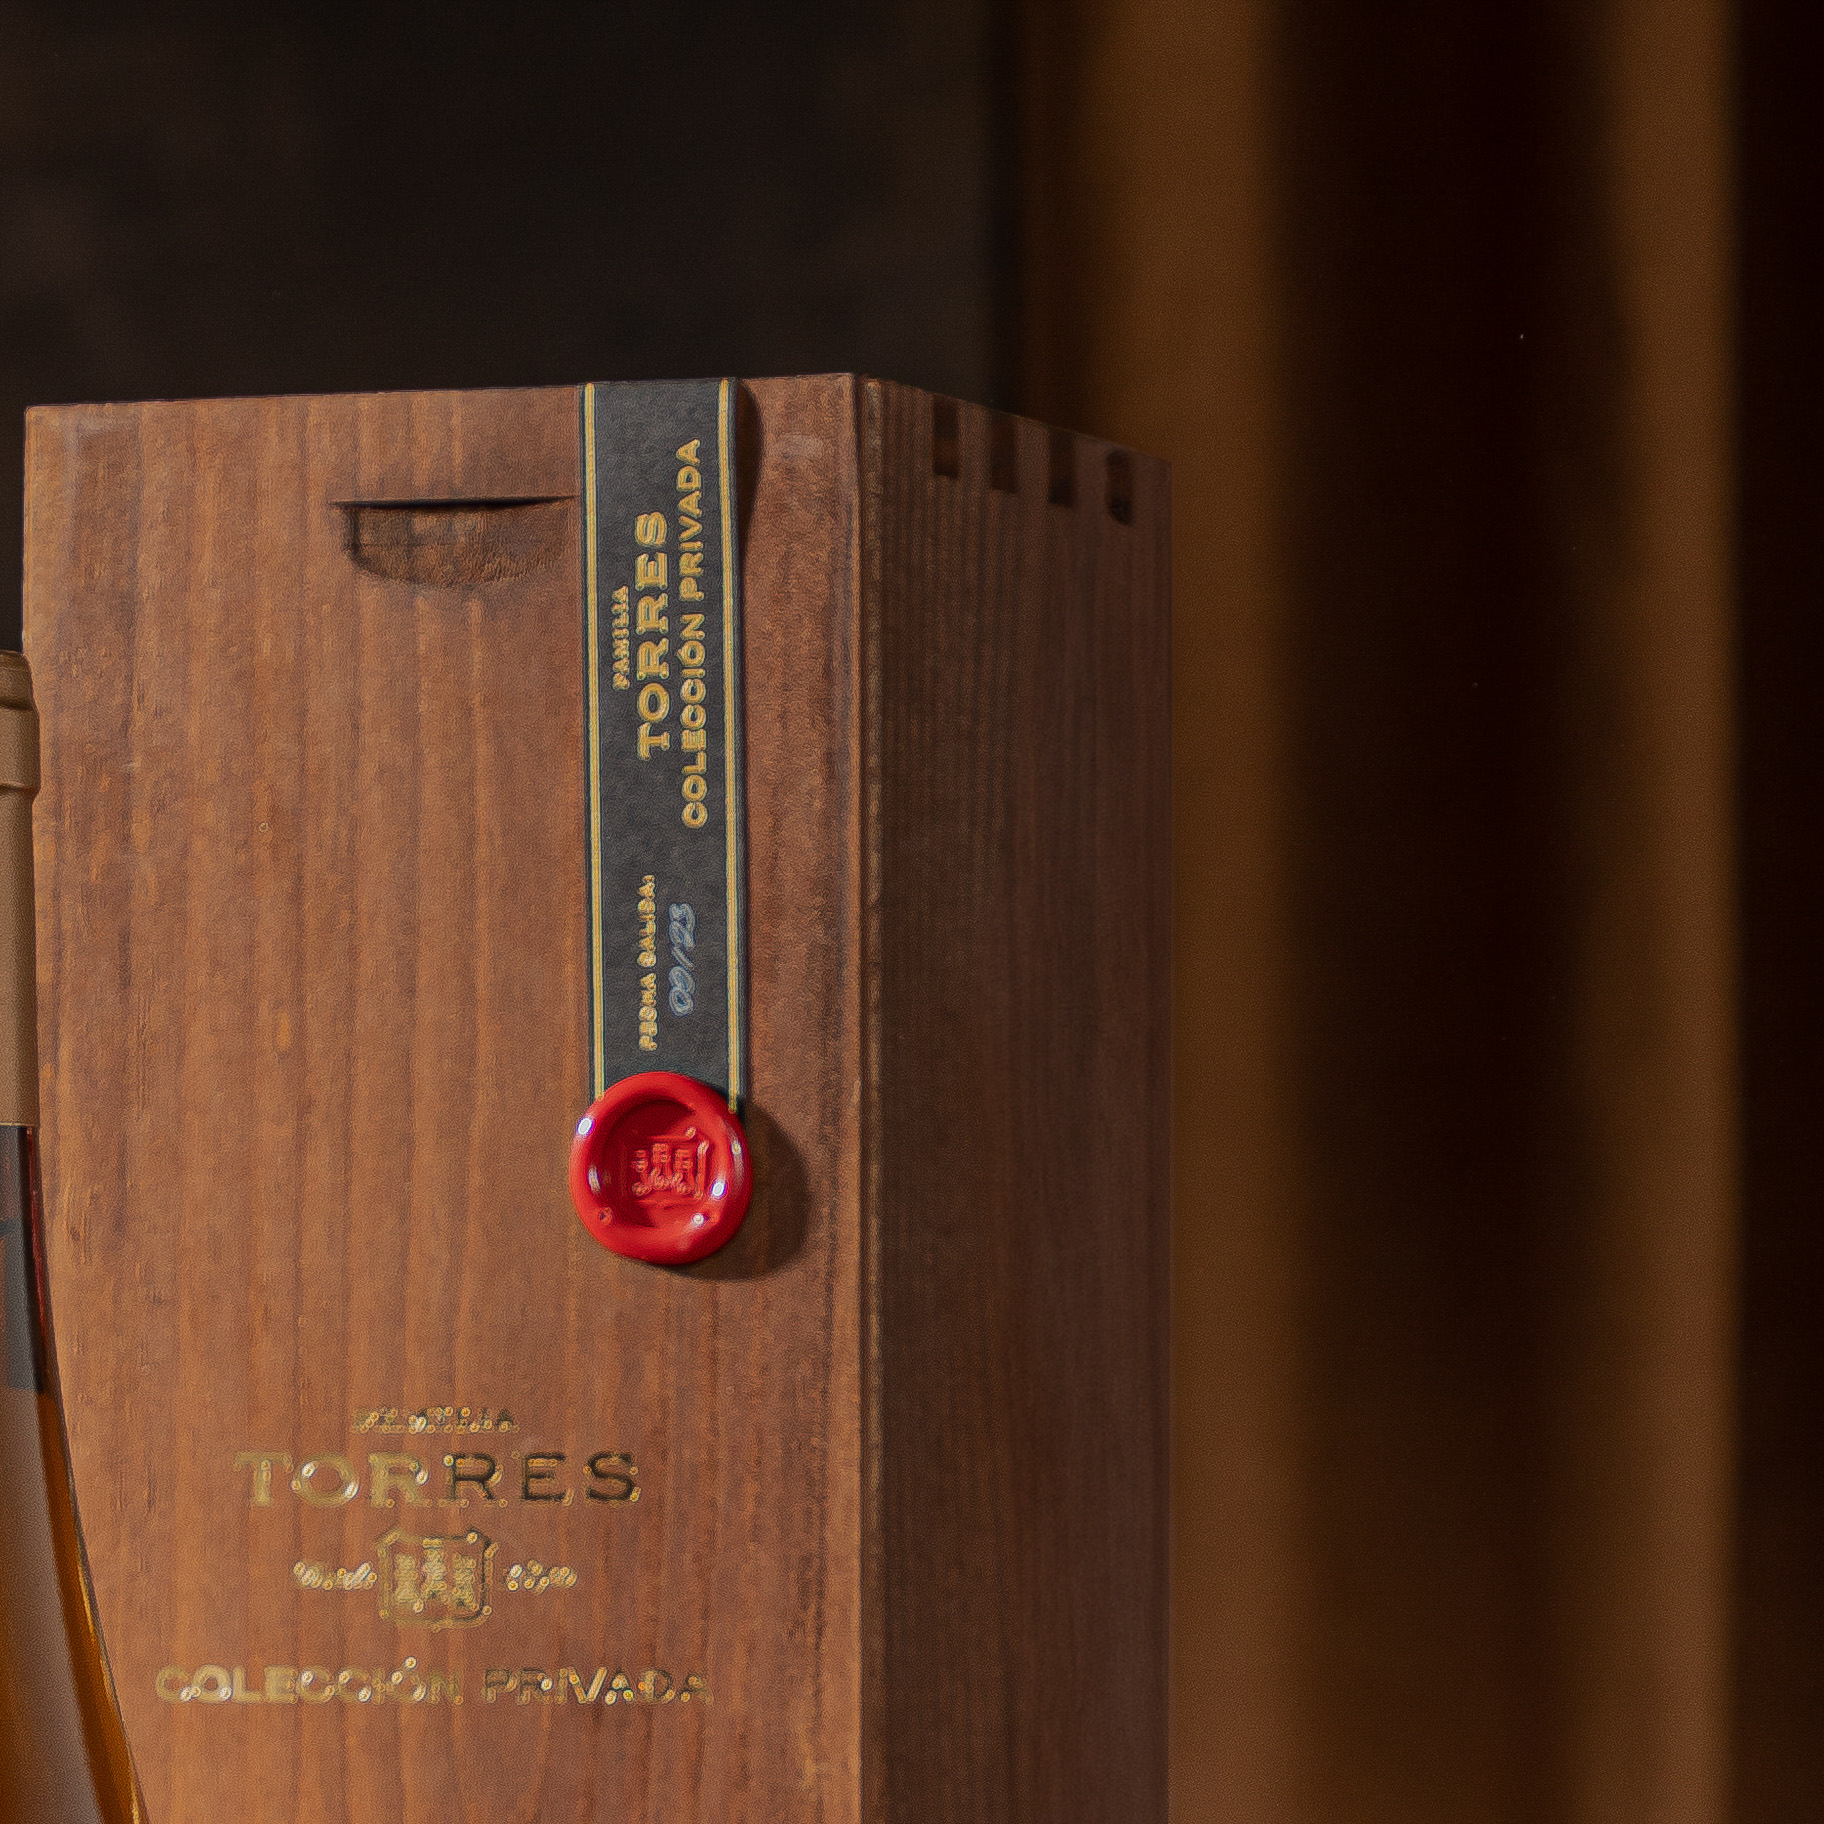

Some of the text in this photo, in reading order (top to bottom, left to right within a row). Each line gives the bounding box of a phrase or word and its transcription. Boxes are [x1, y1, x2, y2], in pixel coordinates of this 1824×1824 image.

[612, 585, 630, 690] FAMILIA
[635, 511, 671, 761] TORRES
[677, 438, 709, 829] COLECCIÓN PRIVADA
[231, 1451, 641, 1507] TORRES
[154, 1656, 715, 1705] COLECCIÓN PRIVADA
